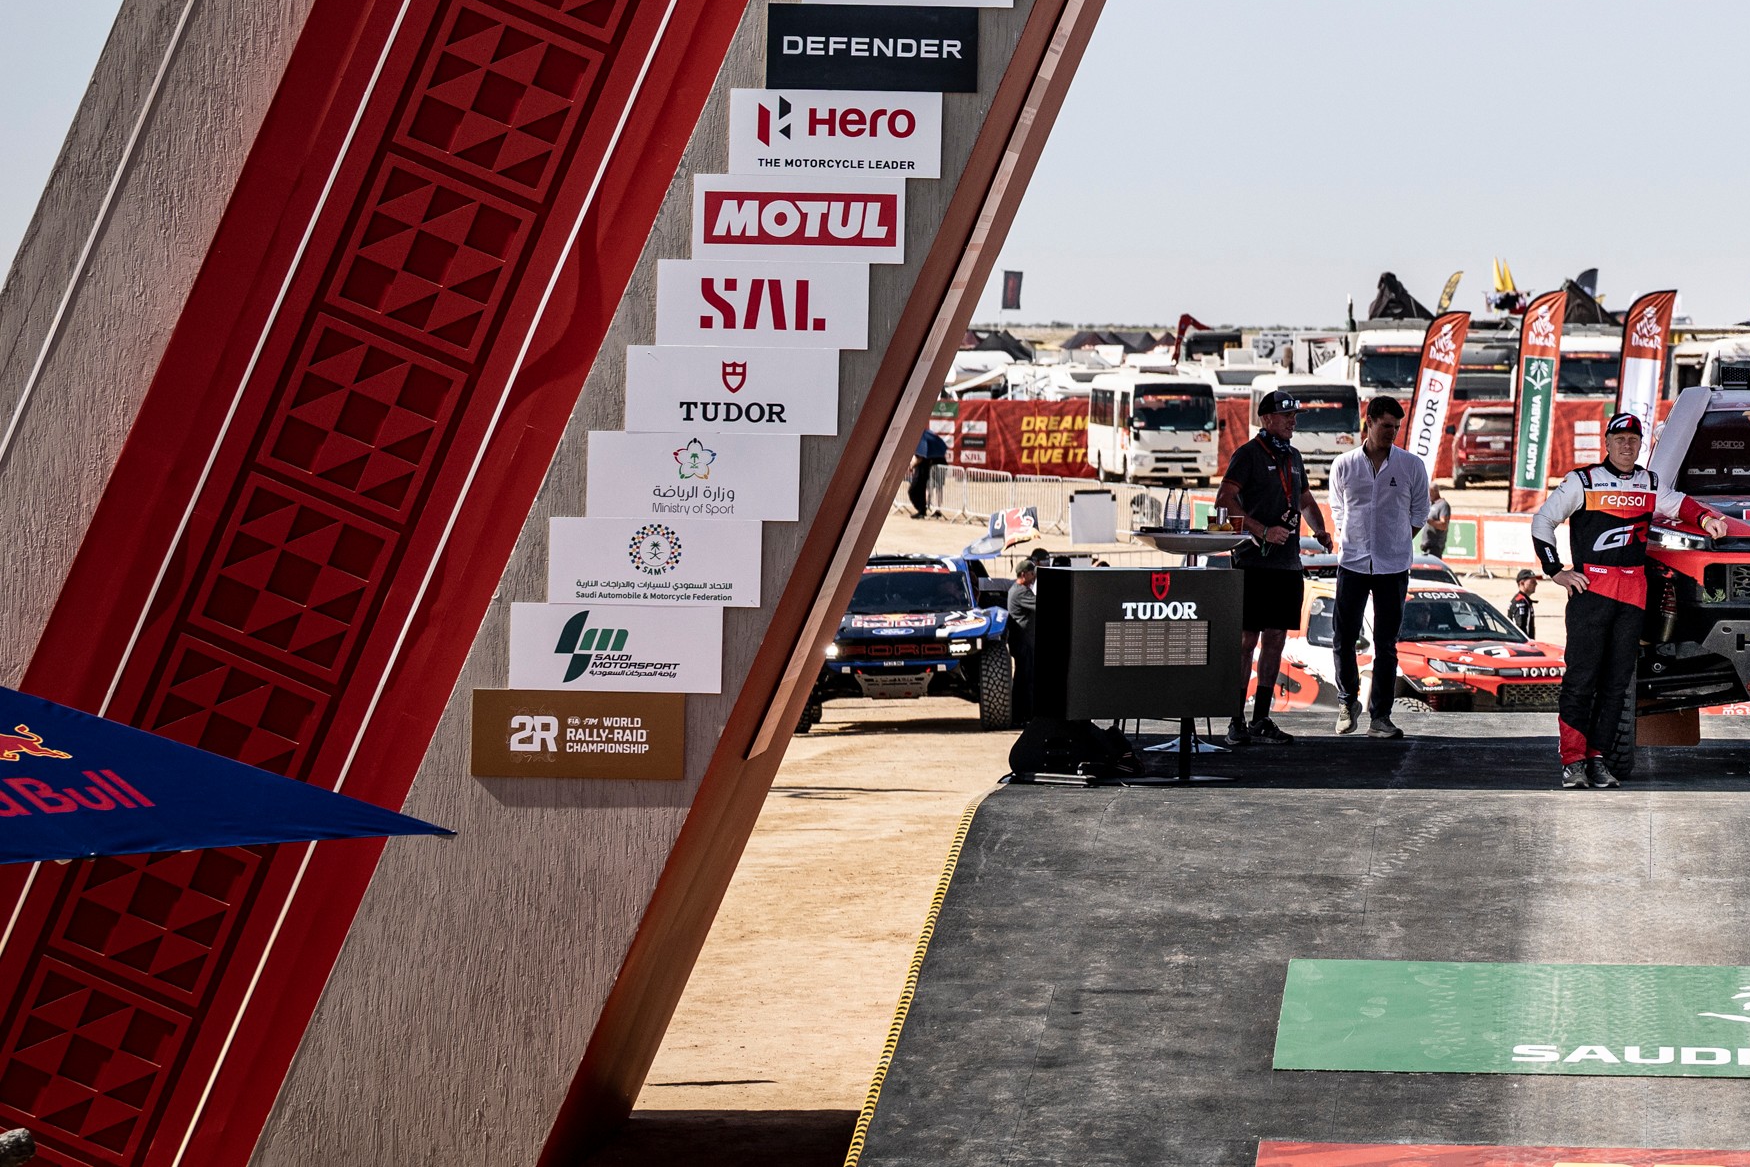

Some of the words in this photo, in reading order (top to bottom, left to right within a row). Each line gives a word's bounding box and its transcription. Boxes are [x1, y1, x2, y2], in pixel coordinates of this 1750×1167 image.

[782, 35, 962, 59] DEFENDER
[808, 107, 916, 138] Hero
[758, 157, 781, 168] THE
[784, 158, 865, 170] MOTORCYCLE
[868, 160, 916, 170] LEADER
[712, 199, 889, 239] MOTUL
[679, 400, 787, 423] TUDOR
[1529, 395, 1543, 442] ARABIA
[1021, 415, 1089, 432] DREAM
[1416, 398, 1440, 457] UDOR
[1021, 432, 1078, 447] DARE.
[1711, 440, 1745, 449] sparco
[1021, 448, 1063, 464] LIVE
[1525, 442, 1537, 481] SAUDI
[652, 485, 698, 501] الرياضة
[703, 486, 735, 502] وزارة
[1600, 494, 1647, 508] repsol
[652, 502, 690, 515] Ministry
[692, 503, 703, 514] of
[705, 503, 735, 516] Sport
[1592, 520, 1649, 552] GR
[642, 565, 667, 576] SAMF
[672, 581, 707, 591] السعودي
[575, 591, 597, 599] Saudi
[598, 591, 641, 600] Automobile
[642, 592, 649, 600] &
[650, 592, 691, 602] Motorcycle
[692, 593, 733, 601] Federation
[1418, 591, 1460, 600] repsol
[1121, 601, 1198, 620] TUDOR
[594, 654, 632, 662] SAUDI
[591, 662, 681, 670] MOTORSPORT
[1521, 666, 1567, 678] TOYOT
[567, 717, 581, 726] FIA
[602, 717, 642, 728] WORLD
[510, 715, 559, 752] 2R
[566, 728, 647, 742] RALLY-RAID
[566, 742, 650, 754] CHAMPIONSHIP
[2, 769, 156, 814] Bull
